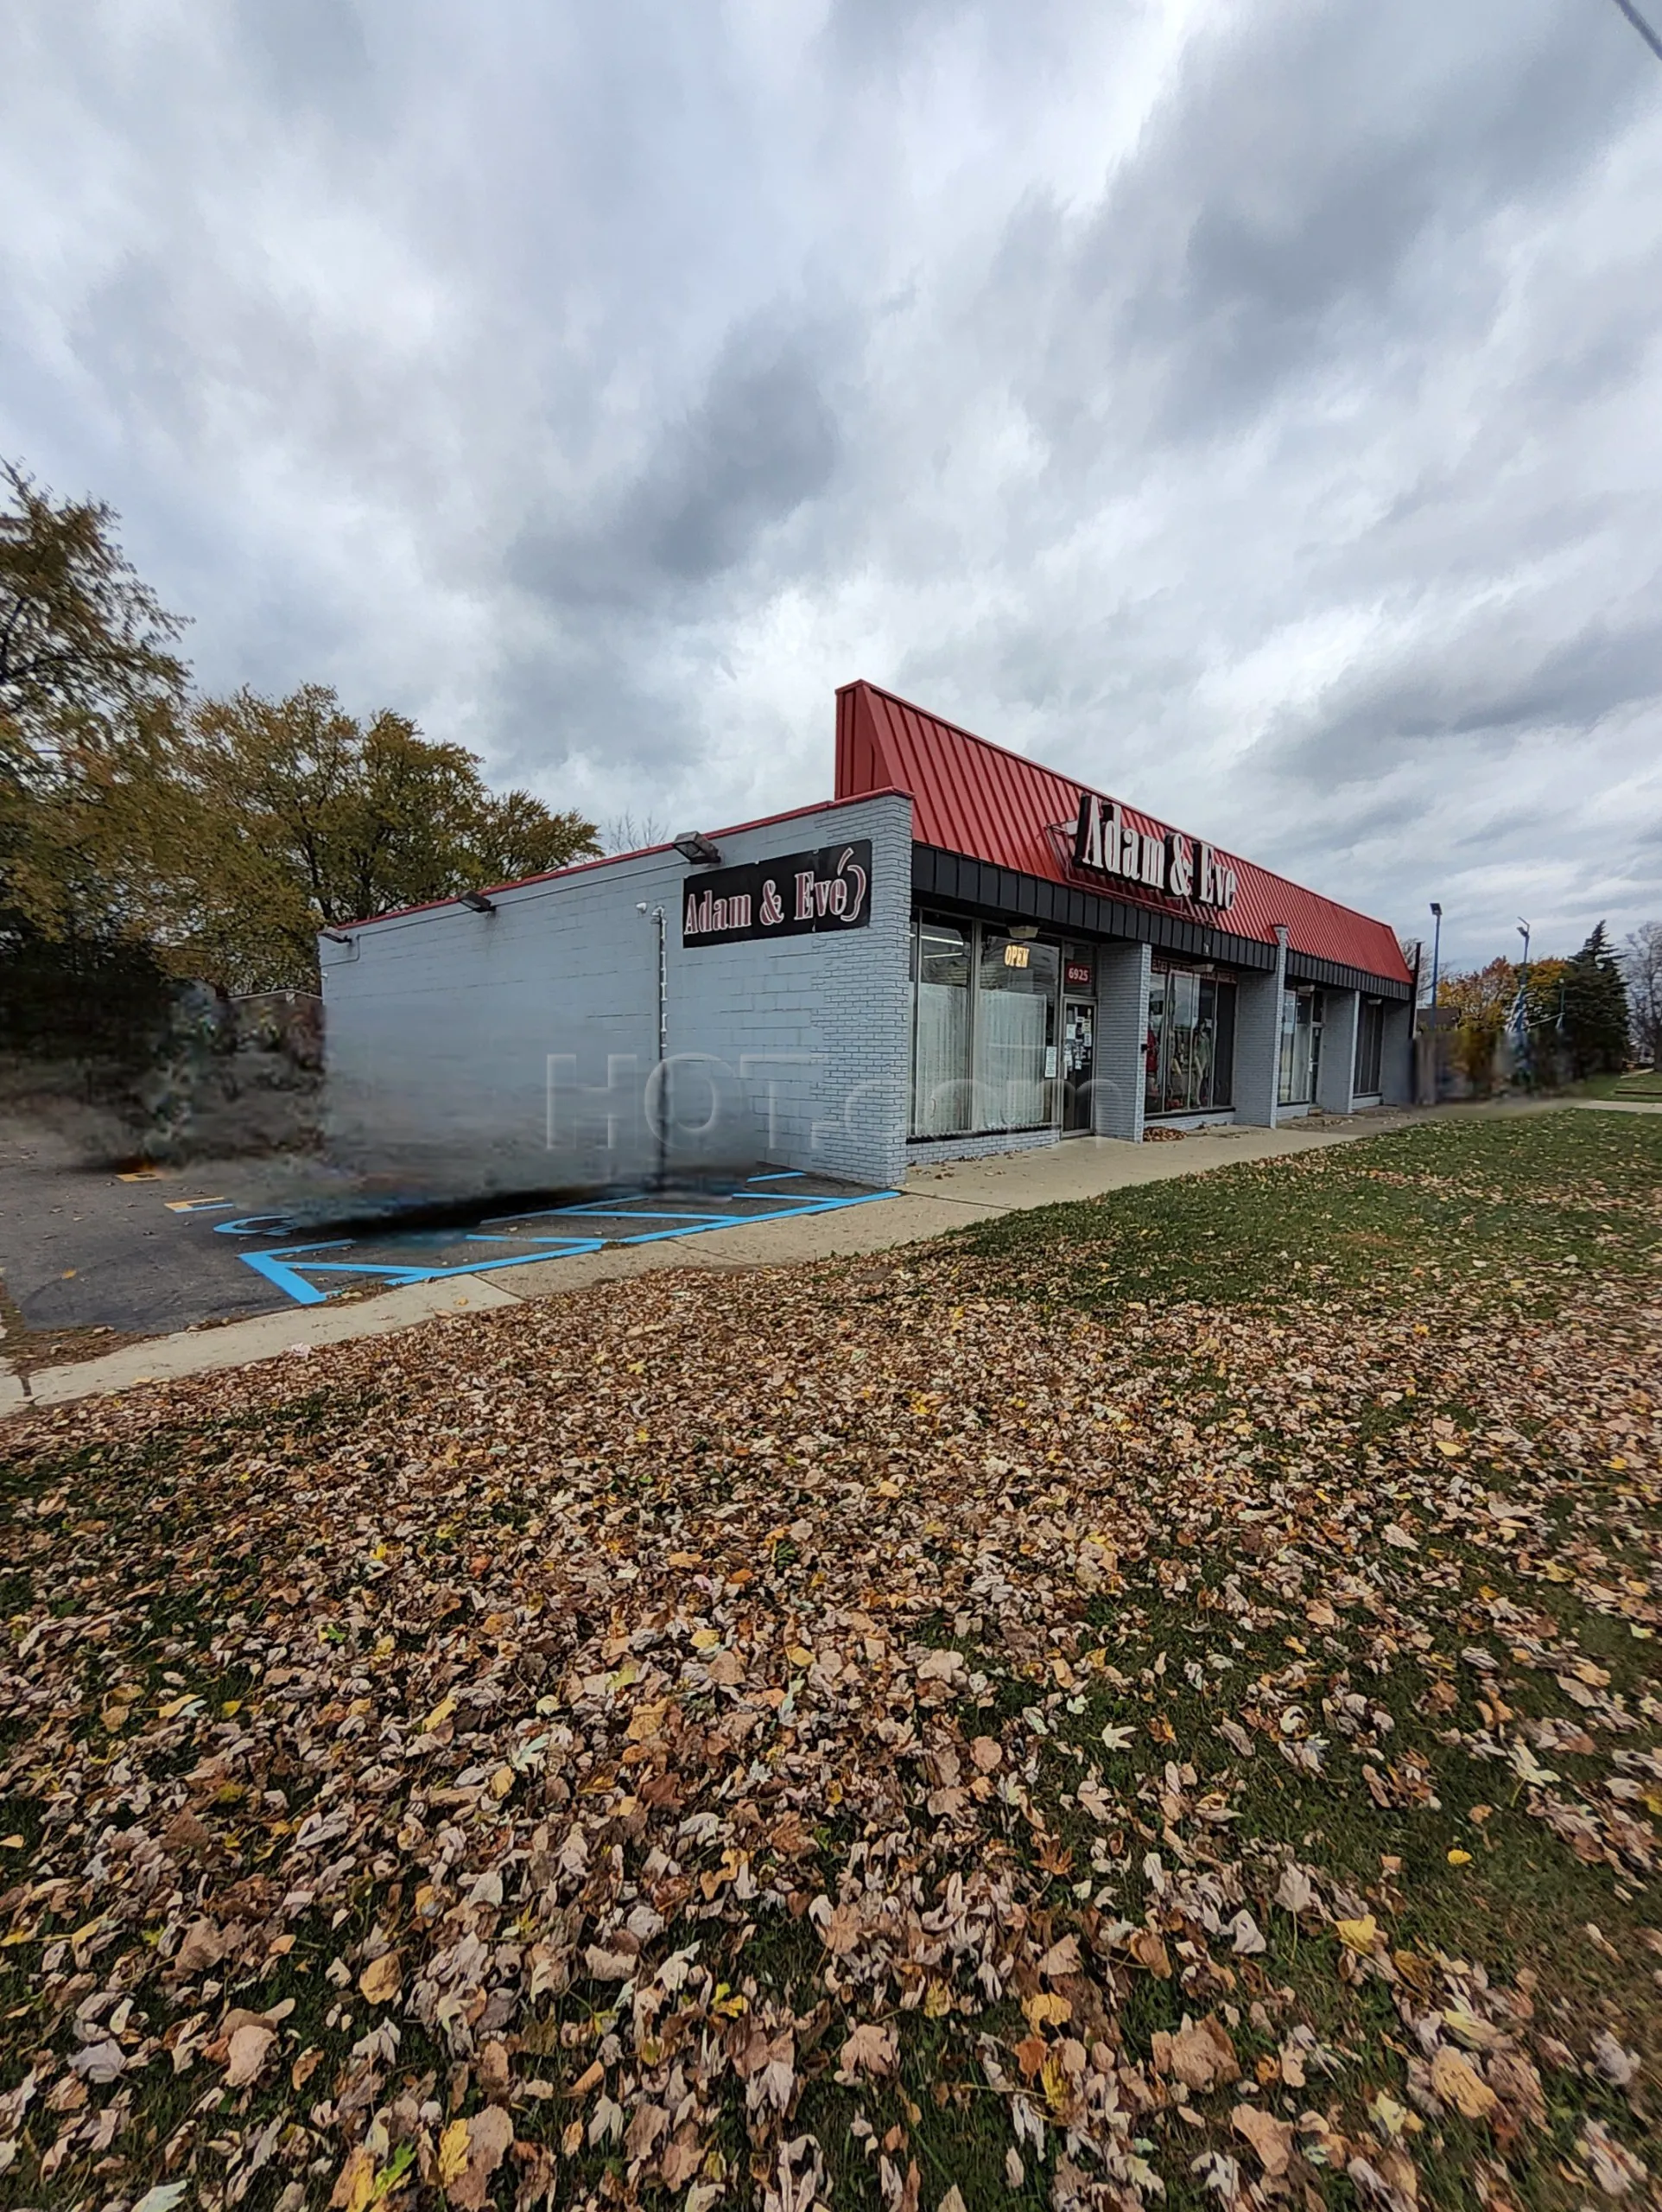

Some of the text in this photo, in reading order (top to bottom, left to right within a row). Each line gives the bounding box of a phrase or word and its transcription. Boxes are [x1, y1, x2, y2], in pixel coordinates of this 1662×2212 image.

[1082, 793, 1237, 911] Adam & Eve
[683, 871, 848, 936] Adam & Eve
[1004, 944, 1030, 968] OPEN
[1068, 968, 1089, 982] 6925
